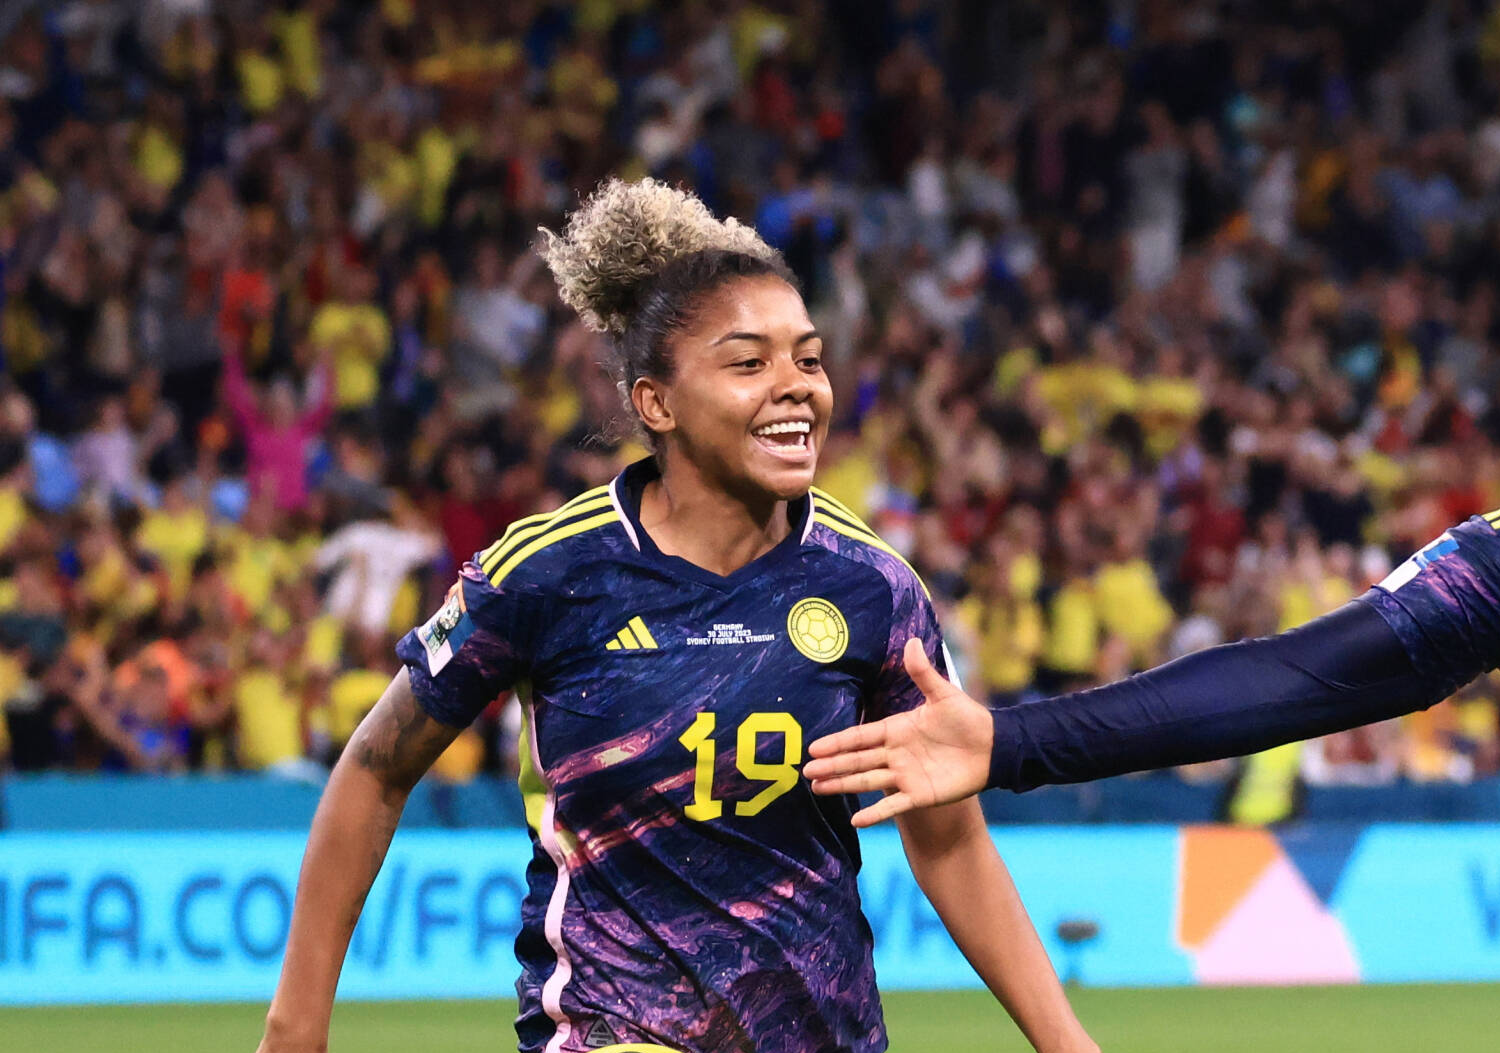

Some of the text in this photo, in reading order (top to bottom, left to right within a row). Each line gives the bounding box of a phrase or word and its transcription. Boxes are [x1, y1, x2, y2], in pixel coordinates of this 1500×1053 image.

[686, 637, 711, 646] SYDNEY
[712, 636, 745, 645] FOOTBALL
[678, 712, 802, 822] 19
[0, 862, 523, 970] IFA.CO/FA
